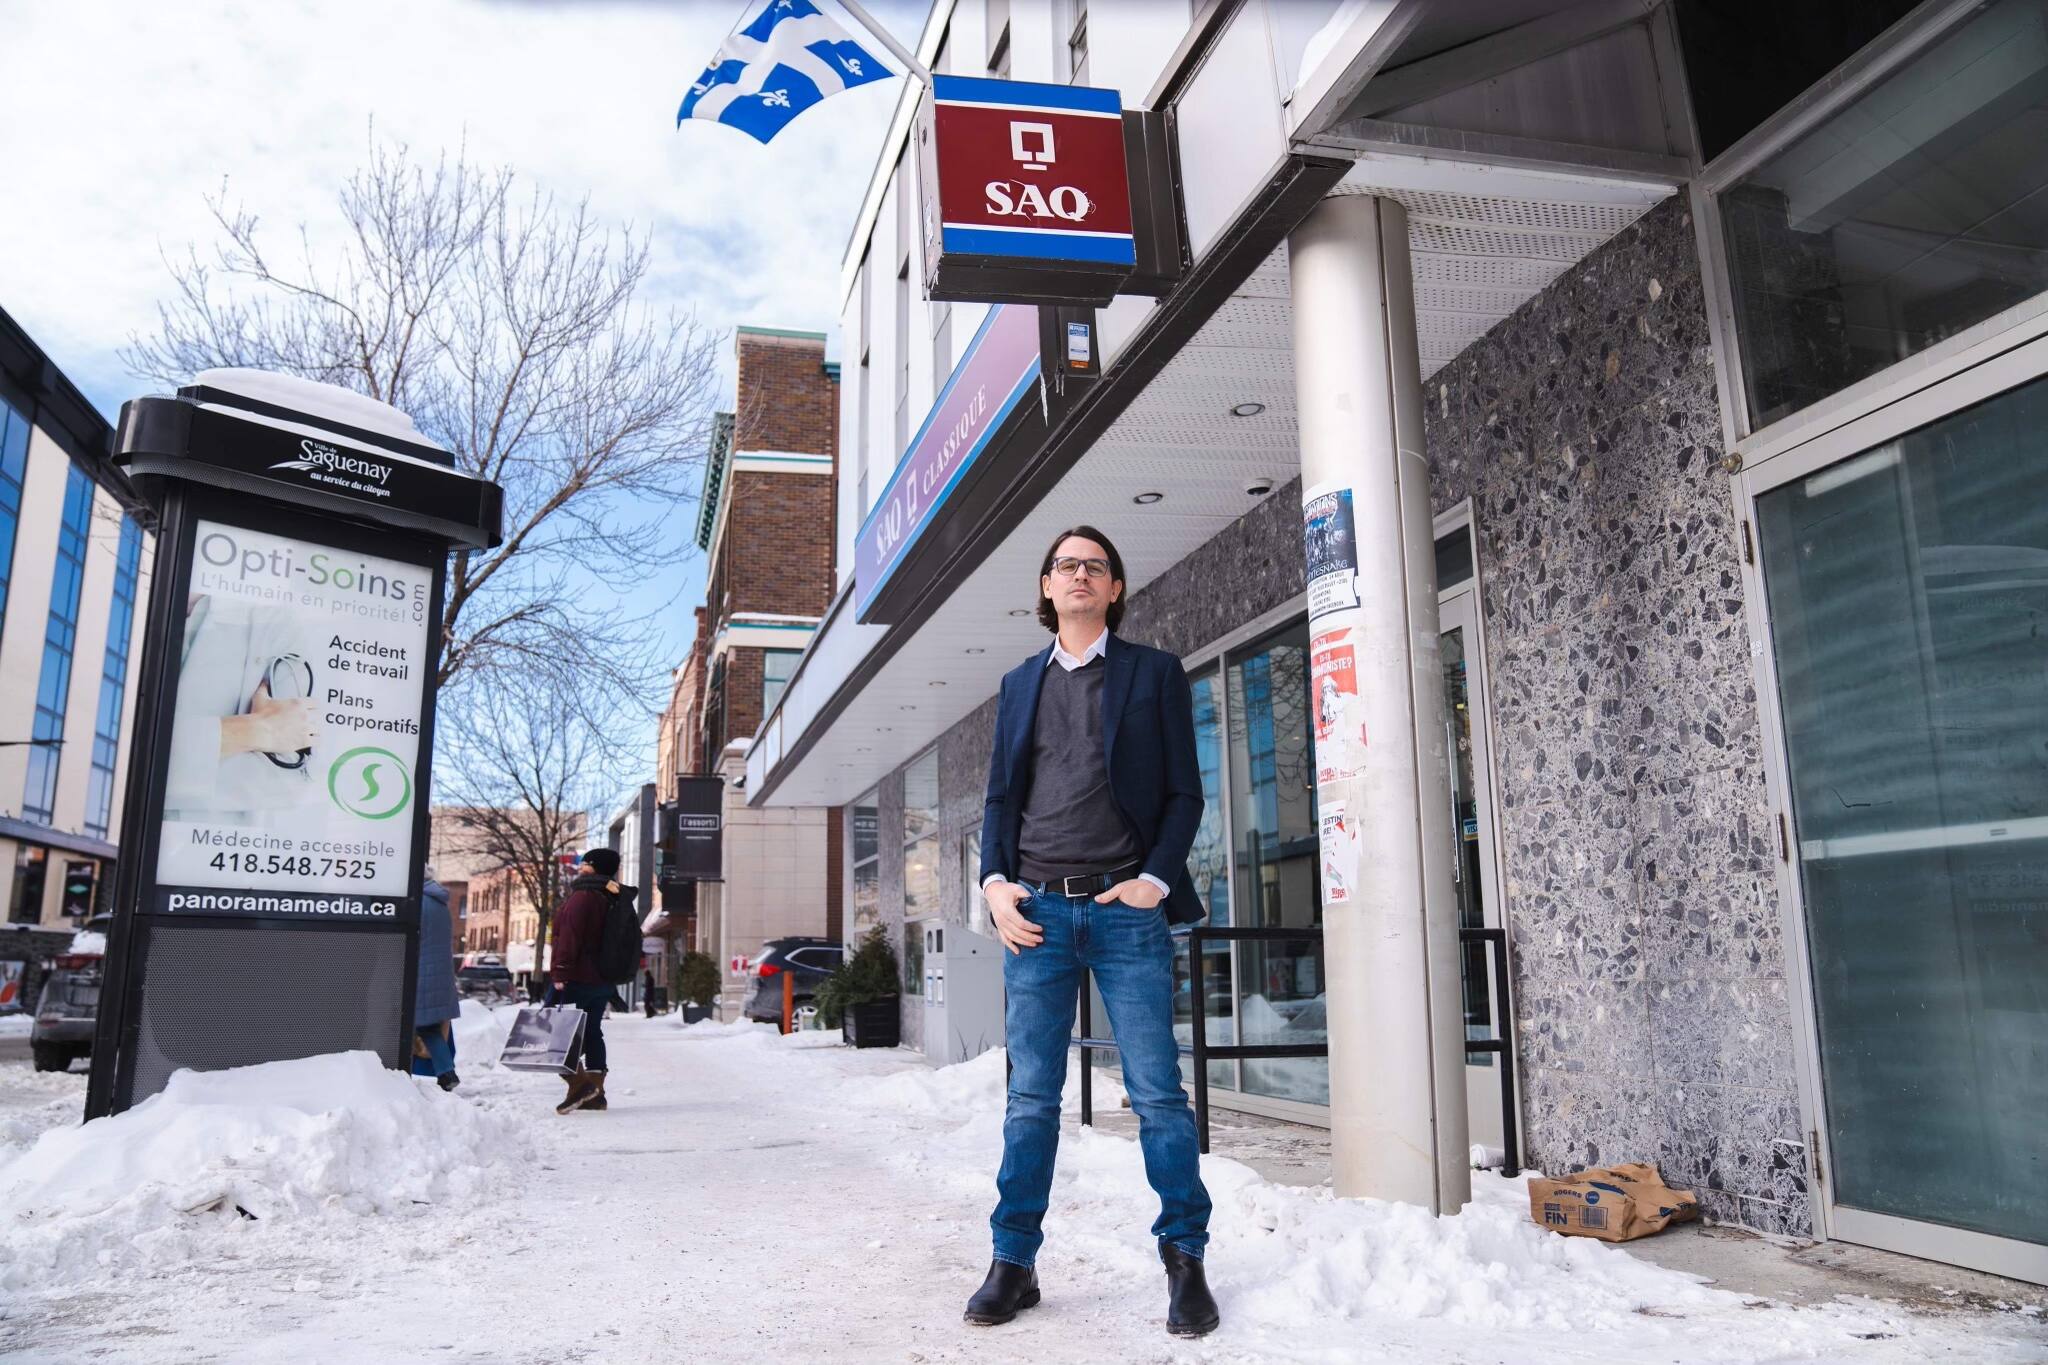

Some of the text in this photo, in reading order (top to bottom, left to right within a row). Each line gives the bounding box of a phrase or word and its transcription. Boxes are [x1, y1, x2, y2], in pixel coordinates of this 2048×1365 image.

[985, 181, 1091, 222] SAQ
[299, 439, 392, 485] Saguenay
[876, 384, 987, 565] SAQ CLASSIQUE
[310, 472, 391, 497] au service du citoyen
[201, 533, 406, 600] Opti-Soins
[201, 572, 406, 623] L'humain en priorité!
[329, 635, 406, 661] Accident
[328, 655, 408, 681] de travail
[327, 689, 373, 709] Plans
[326, 713, 418, 735] corporatifs
[192, 829, 395, 858] Médecine accessible
[210, 853, 376, 879] 418.548.7525
[168, 891, 396, 917] panoramamedia.ca
[1553, 1190, 1582, 1199] ROGERS
[1545, 1212, 1568, 1225] FIN
